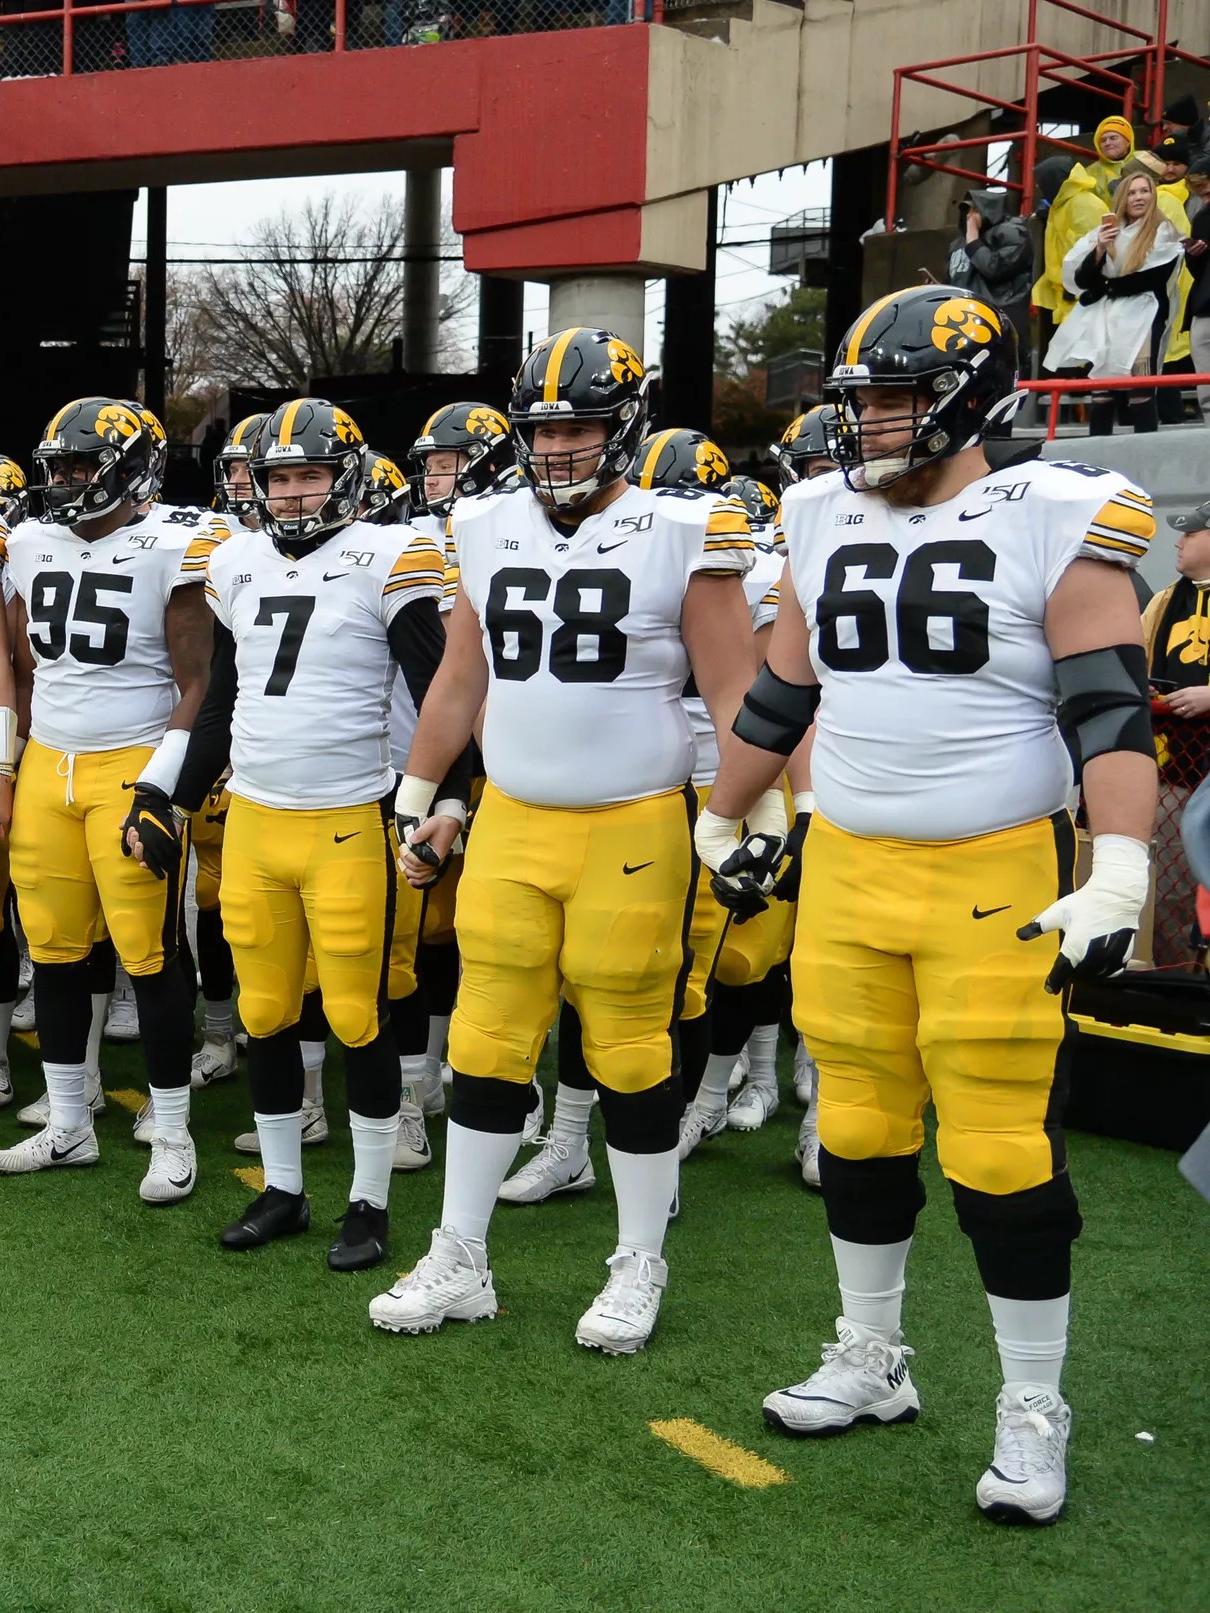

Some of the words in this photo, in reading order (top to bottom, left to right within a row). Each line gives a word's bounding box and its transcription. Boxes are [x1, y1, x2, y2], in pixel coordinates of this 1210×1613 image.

[28, 571, 134, 666] 95
[253, 595, 316, 697] 7
[486, 566, 632, 683] 68
[816, 539, 997, 675] 66
[1028, 1395, 1051, 1411] FORCE
